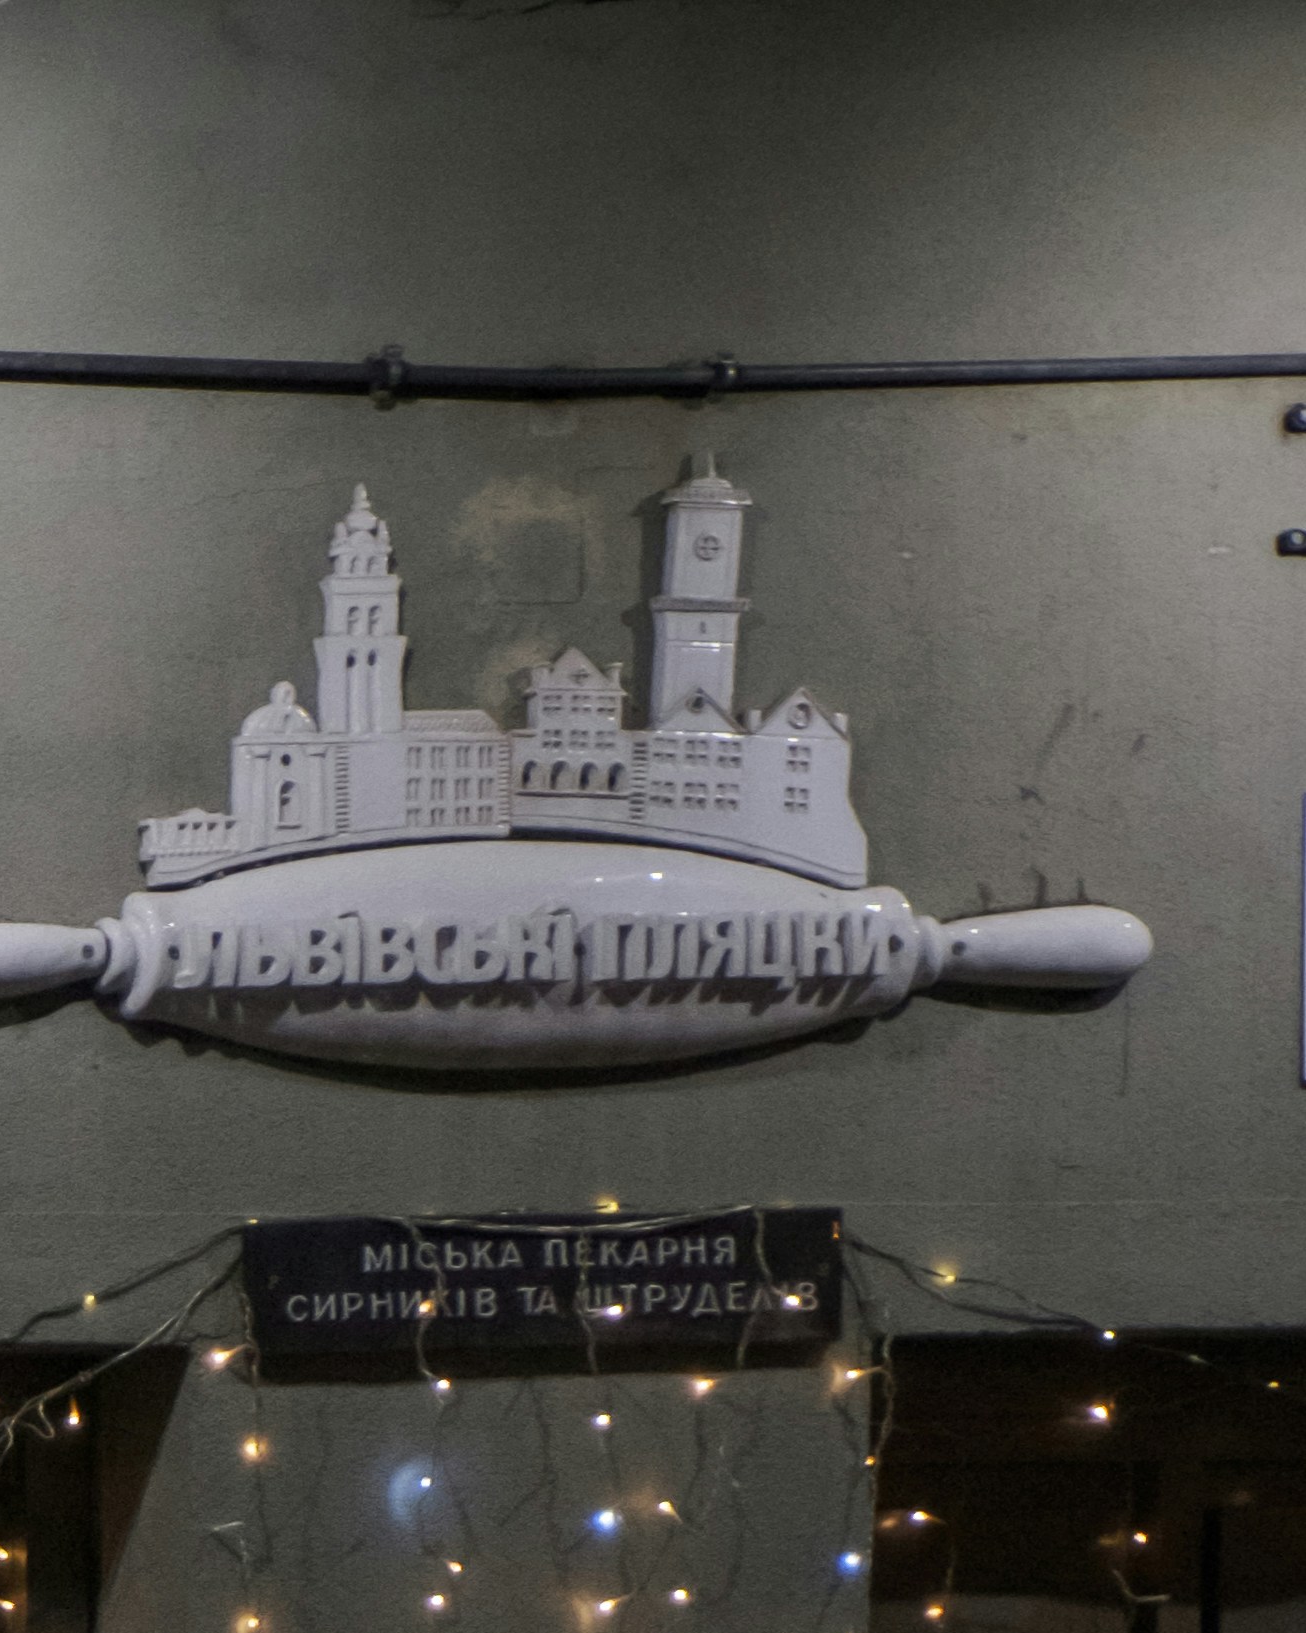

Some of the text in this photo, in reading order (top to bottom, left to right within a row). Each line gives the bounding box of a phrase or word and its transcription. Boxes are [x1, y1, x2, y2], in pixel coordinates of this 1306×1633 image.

[173, 909, 888, 991] ЛЬВІВСЬКІ ПЛЯЦКИ
[362, 1236, 737, 1273] МІСЬКА ПЕКАРНЯ
[287, 1286, 498, 1323] СИРНИКІВ
[517, 1285, 559, 1318] ТА
